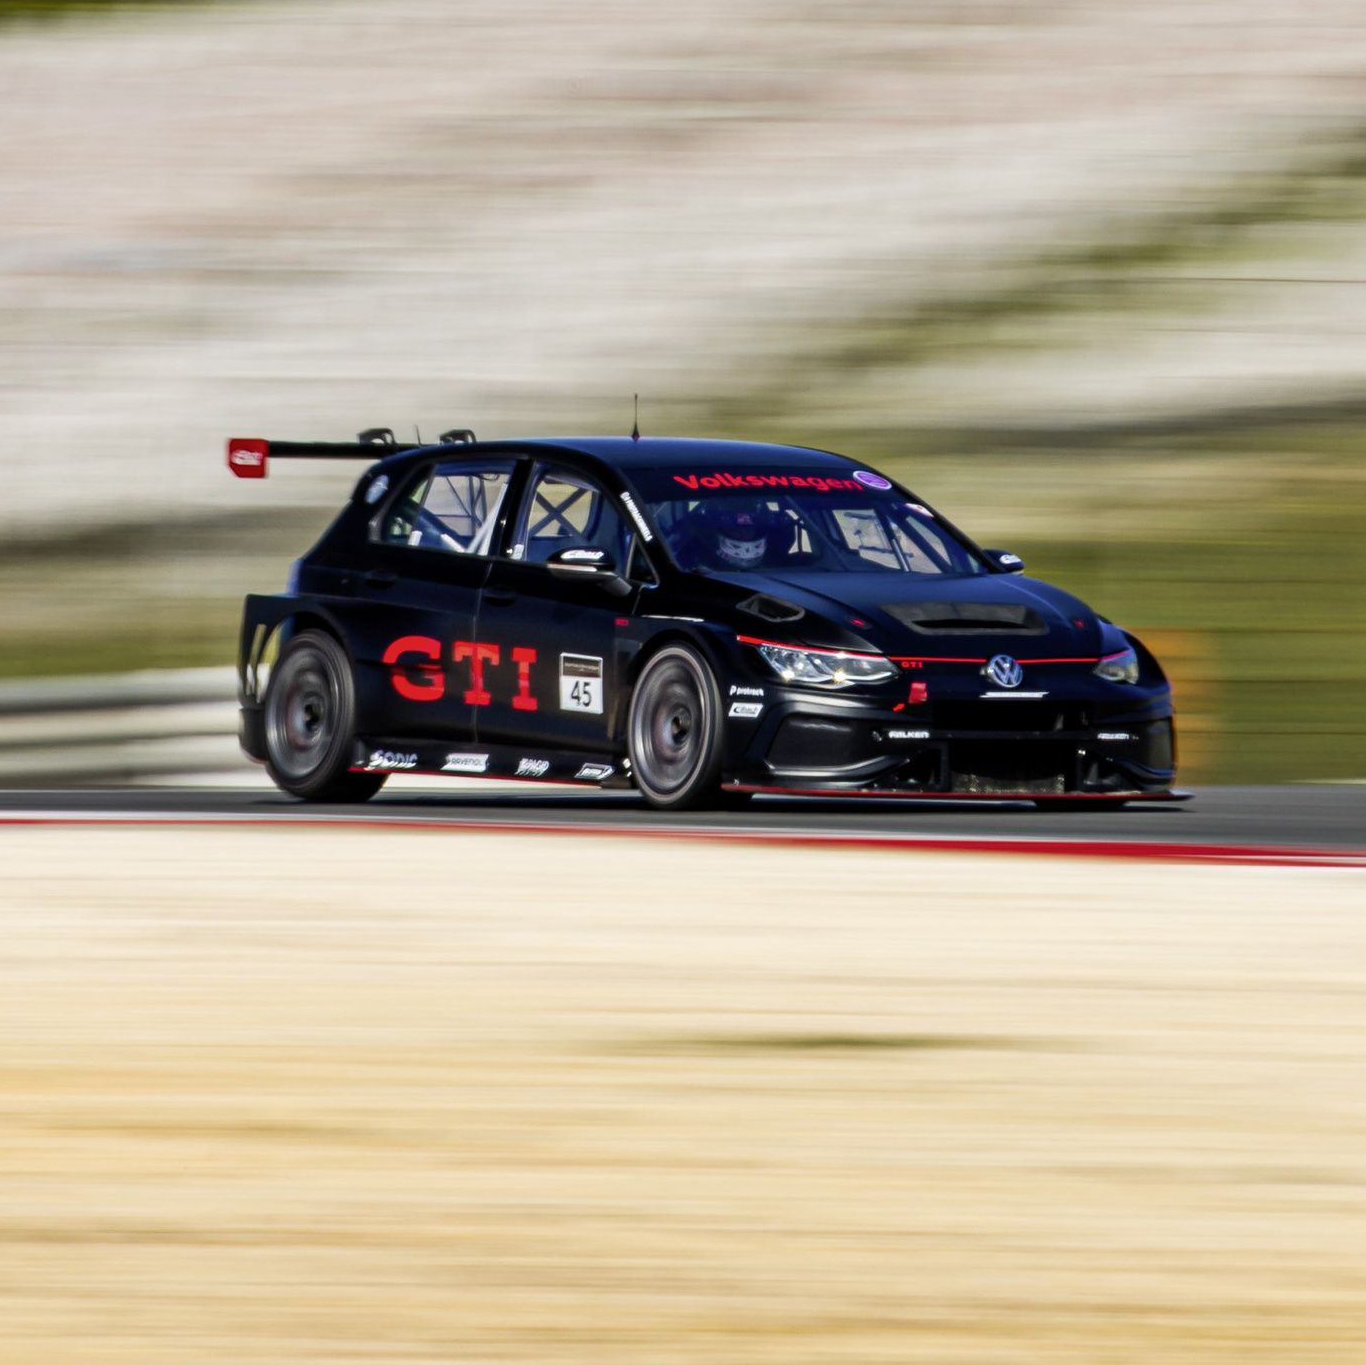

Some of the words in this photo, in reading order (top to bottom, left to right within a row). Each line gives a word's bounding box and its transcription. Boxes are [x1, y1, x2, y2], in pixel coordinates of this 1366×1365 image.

[673, 473, 864, 491] Volkswagen
[382, 635, 538, 711] GTI
[570, 680, 592, 707] 45
[888, 730, 930, 739] FALKEN
